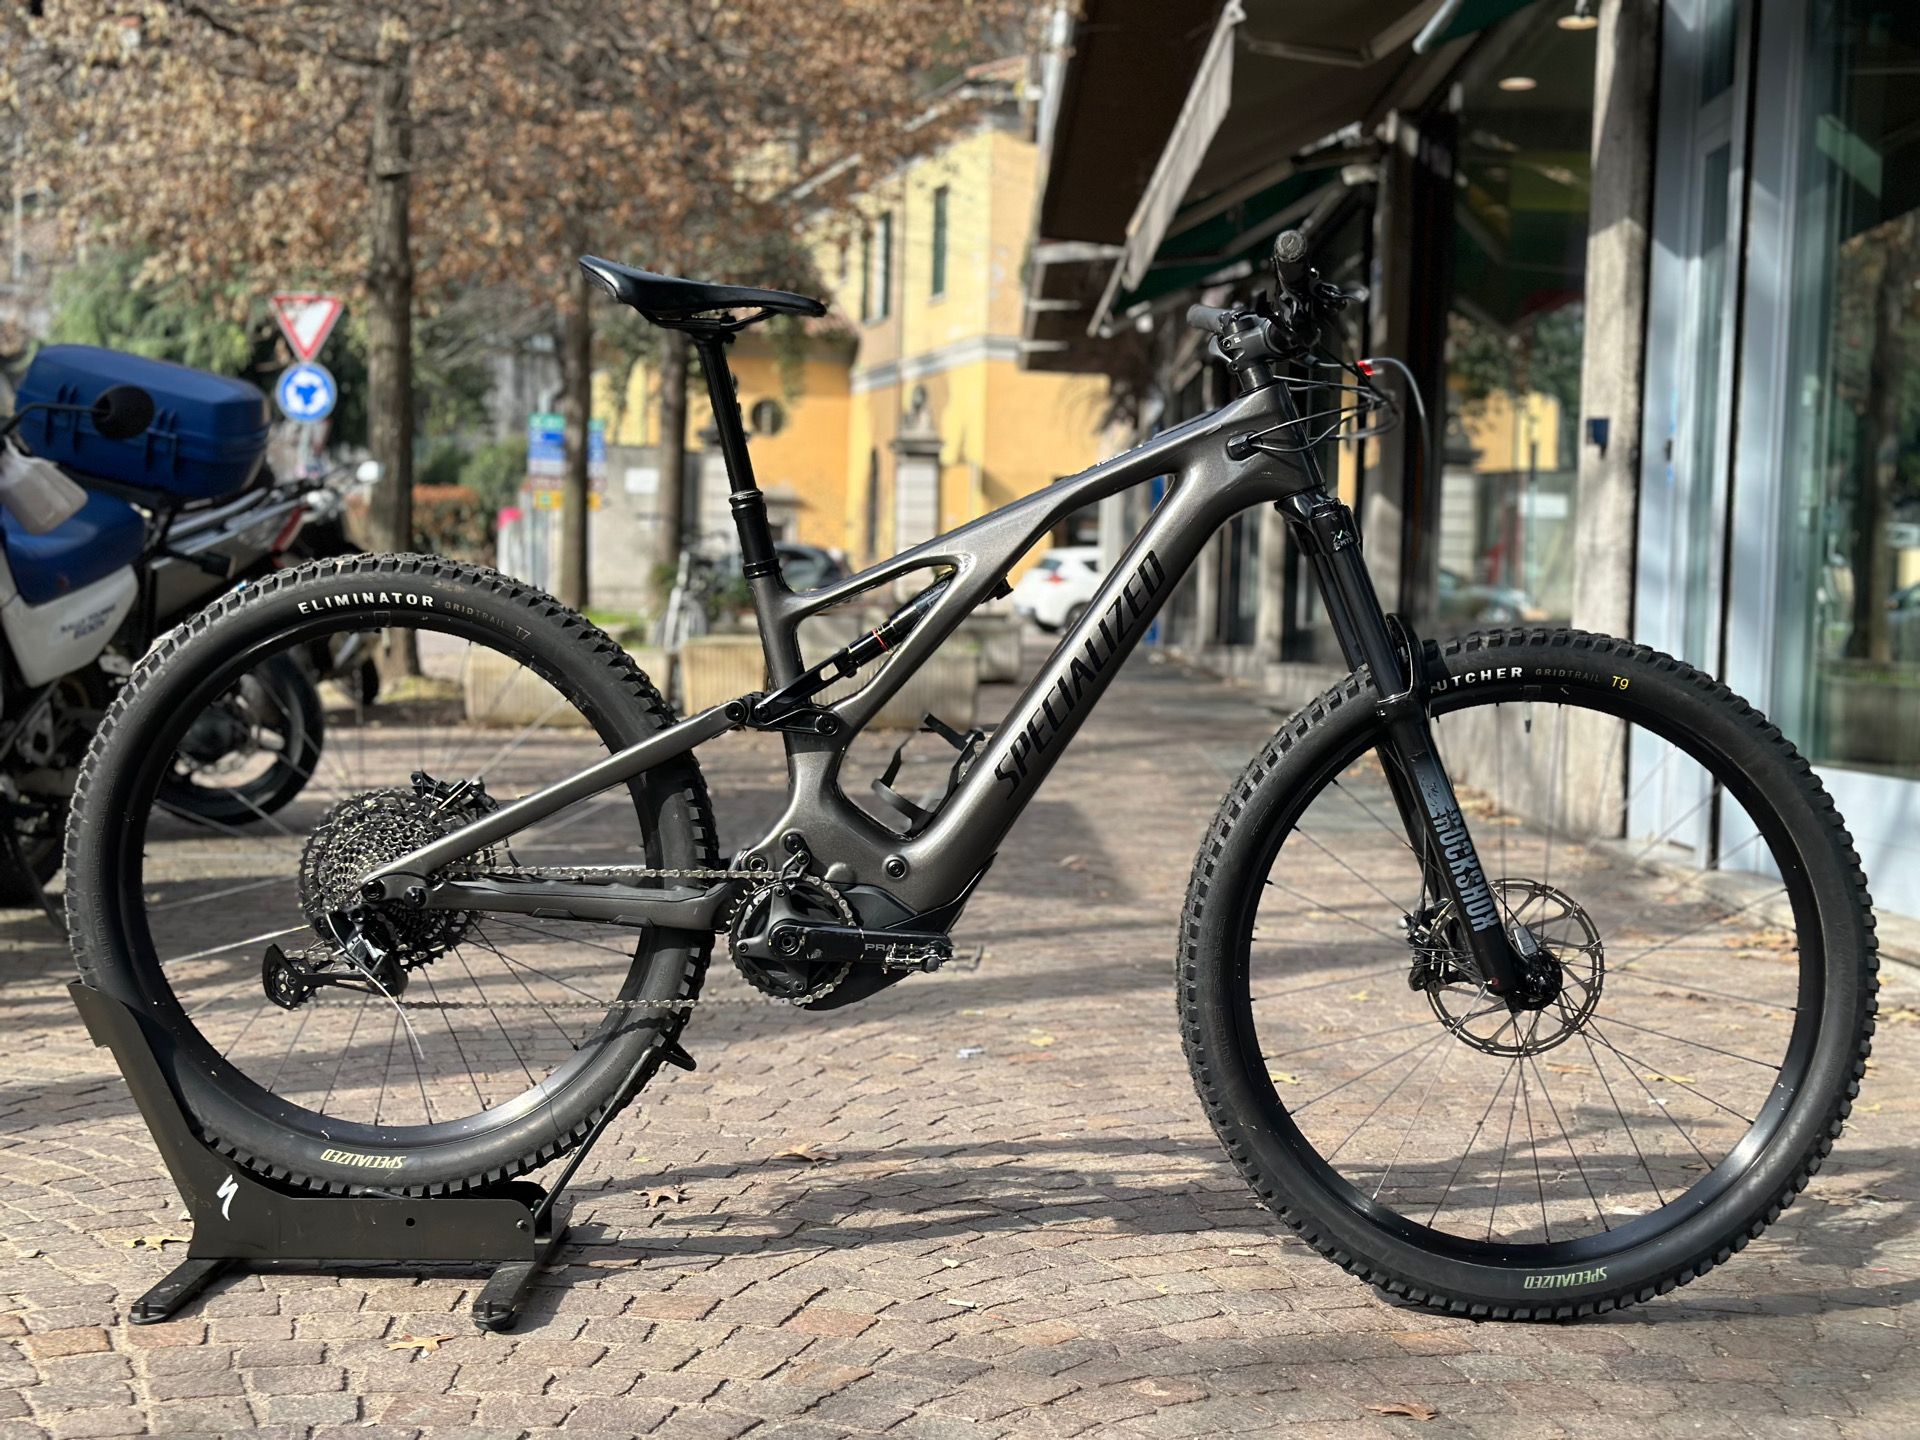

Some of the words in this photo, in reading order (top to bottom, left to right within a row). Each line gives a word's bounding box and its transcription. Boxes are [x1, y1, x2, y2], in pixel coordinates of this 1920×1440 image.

[297, 592, 434, 615] ELIMINATOR
[515, 624, 532, 641] T7
[993, 550, 1166, 801] SPECIALIZED
[1611, 675, 1630, 691] T9
[1432, 808, 1500, 932] ROCKSHOX
[320, 1148, 407, 1169] SPECIALIZED
[1523, 1266, 1608, 1289] SPECIALIZED
